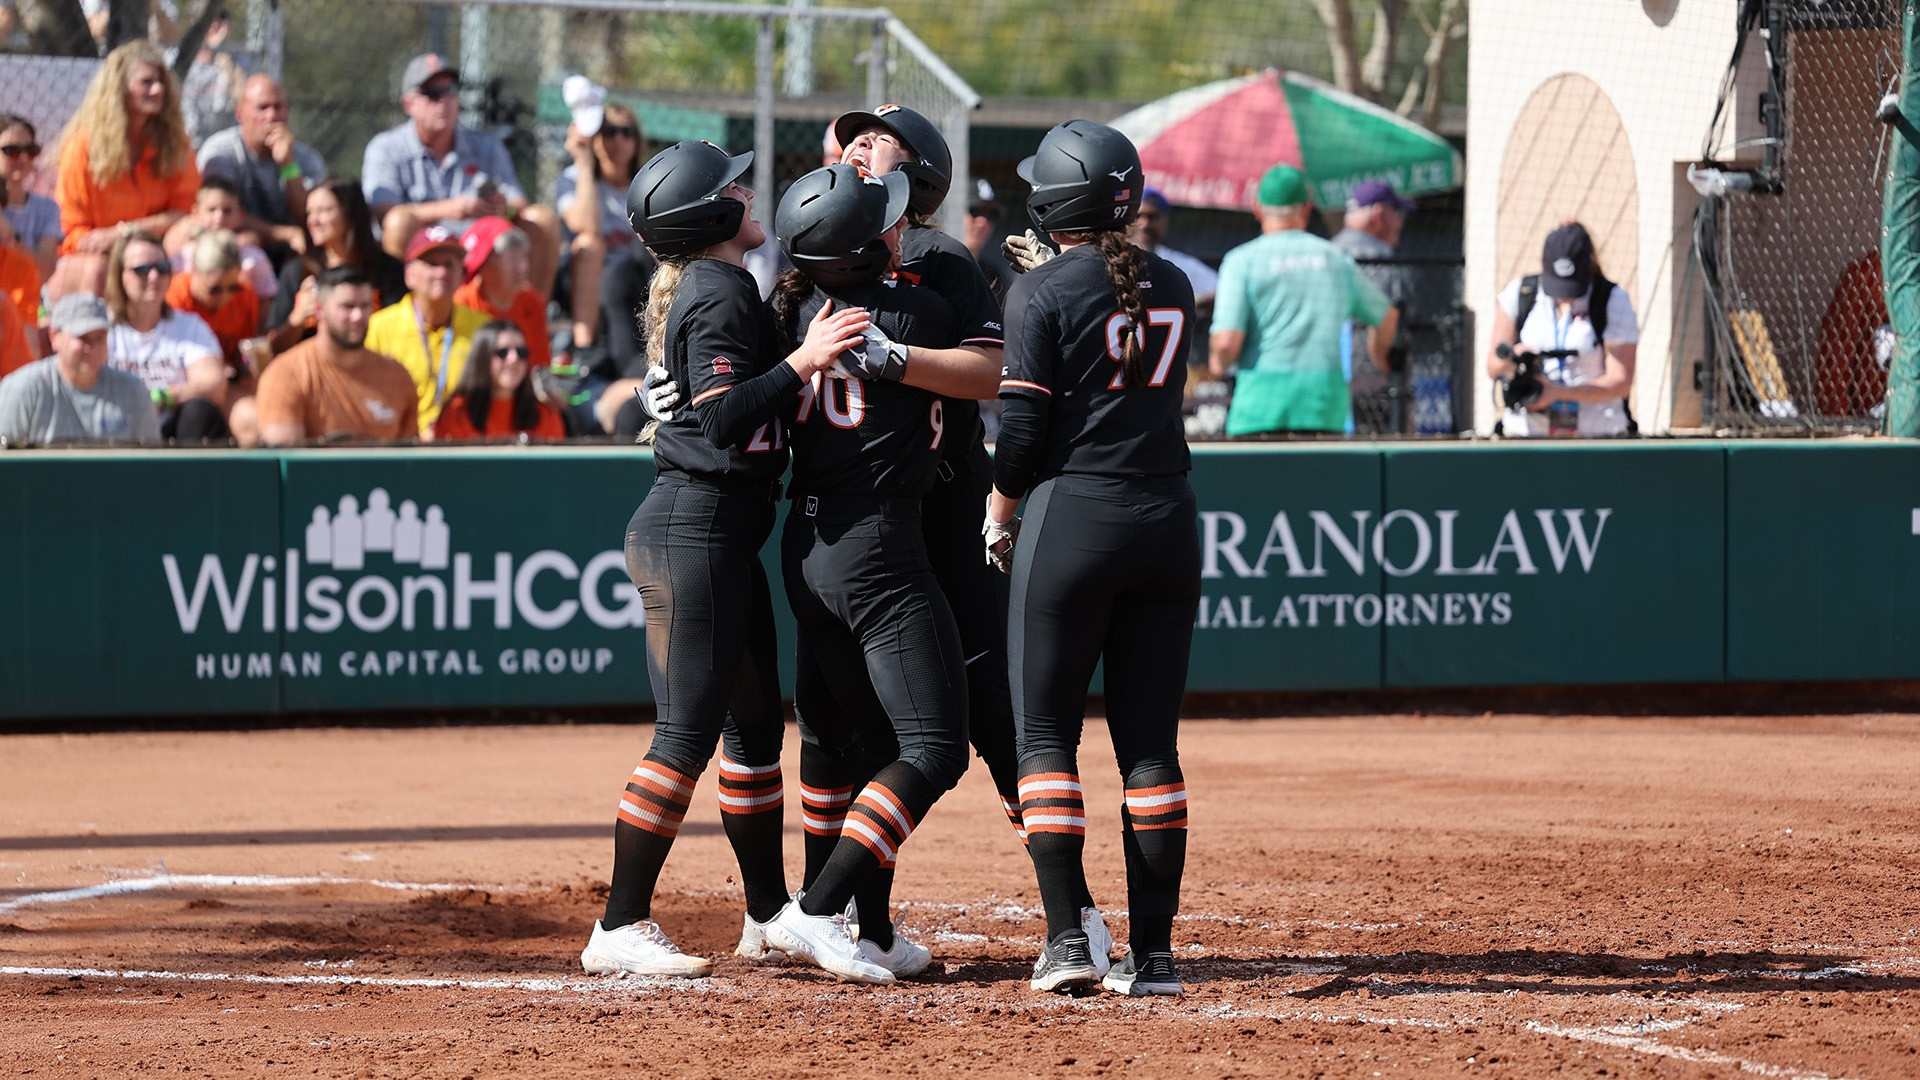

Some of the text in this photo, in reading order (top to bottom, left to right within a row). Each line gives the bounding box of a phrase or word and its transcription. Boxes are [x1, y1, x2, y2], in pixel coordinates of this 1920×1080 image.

[1114, 205, 1129, 219] 97
[982, 321, 1001, 331] ACC
[1105, 308, 1184, 389] 97
[1199, 508, 1612, 579] RANOLAW
[162, 547, 646, 633] WilsonHCG
[1271, 593, 1512, 628] ATTORNEYS
[196, 648, 613, 678] HUMAN CAPITAL GROUP
